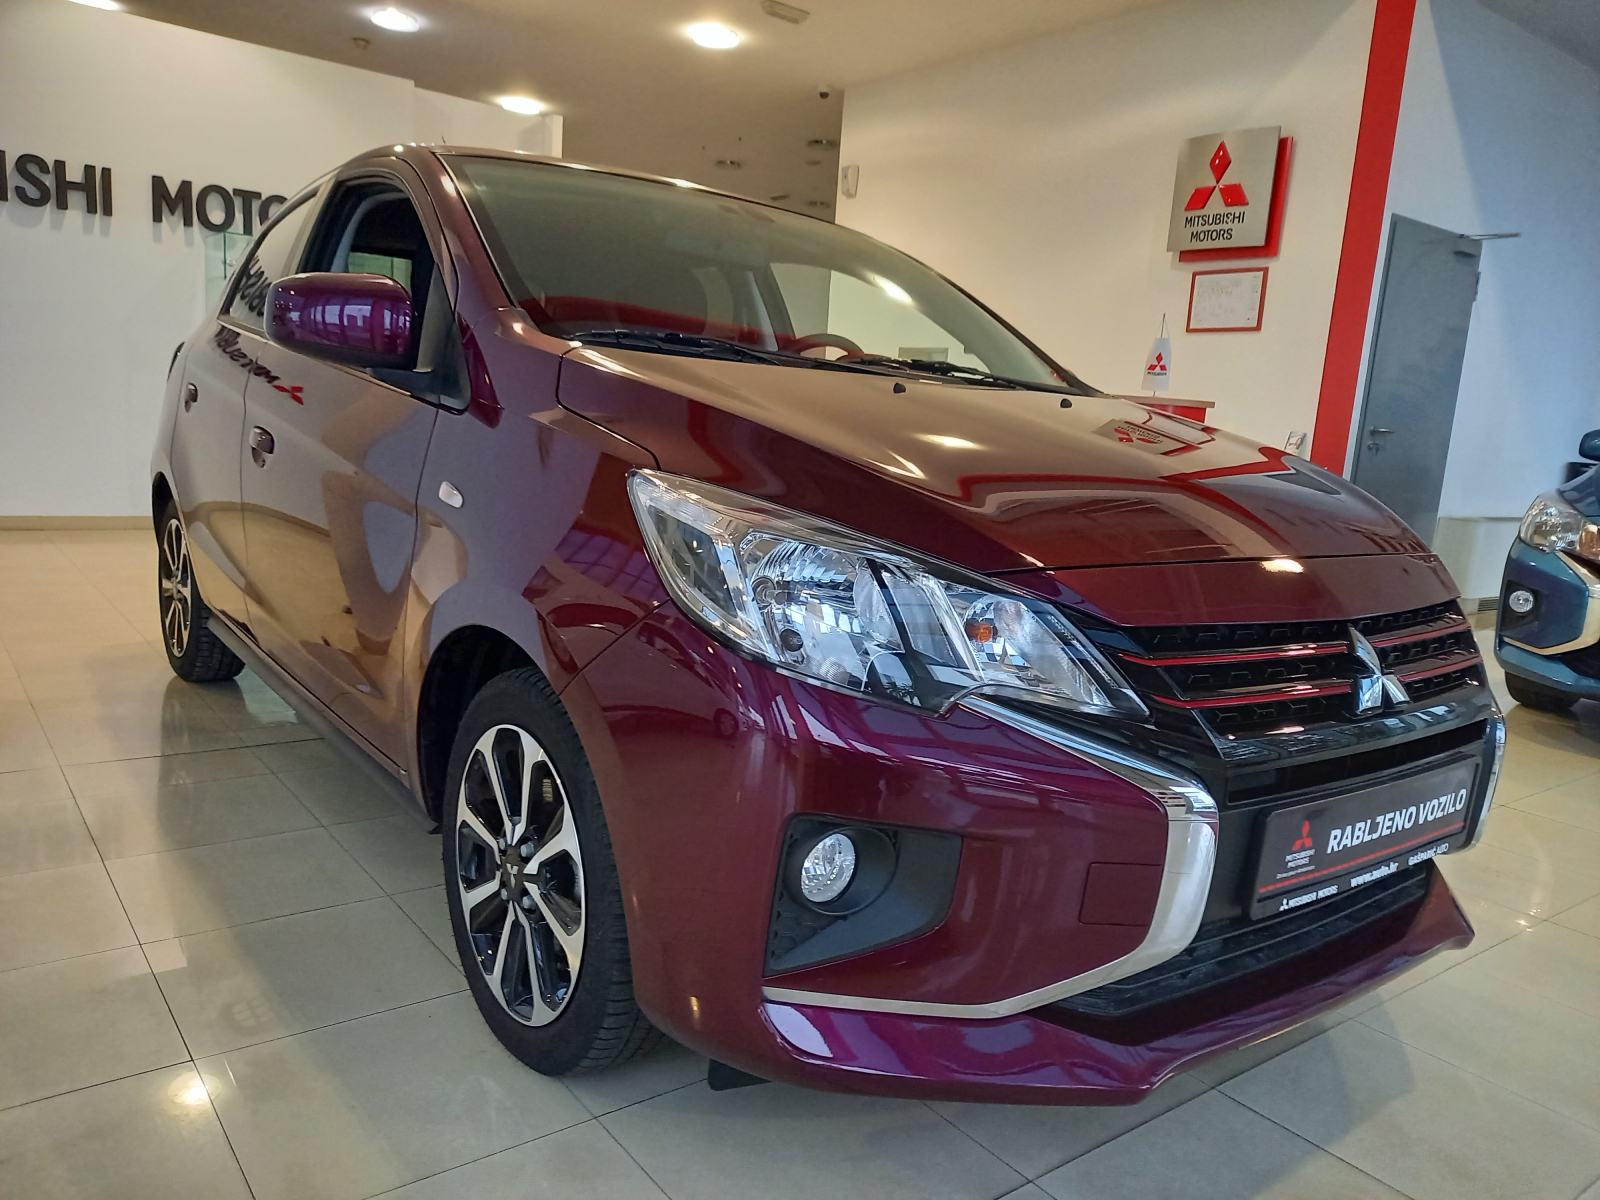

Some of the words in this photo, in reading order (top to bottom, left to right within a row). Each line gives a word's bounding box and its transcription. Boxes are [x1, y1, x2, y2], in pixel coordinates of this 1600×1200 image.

[1184, 210, 1246, 229] MITSUBISHI
[1190, 228, 1233, 243] MOTORS
[1326, 805, 1417, 854] RABLJENO
[1418, 788, 1467, 825] VOZILO
